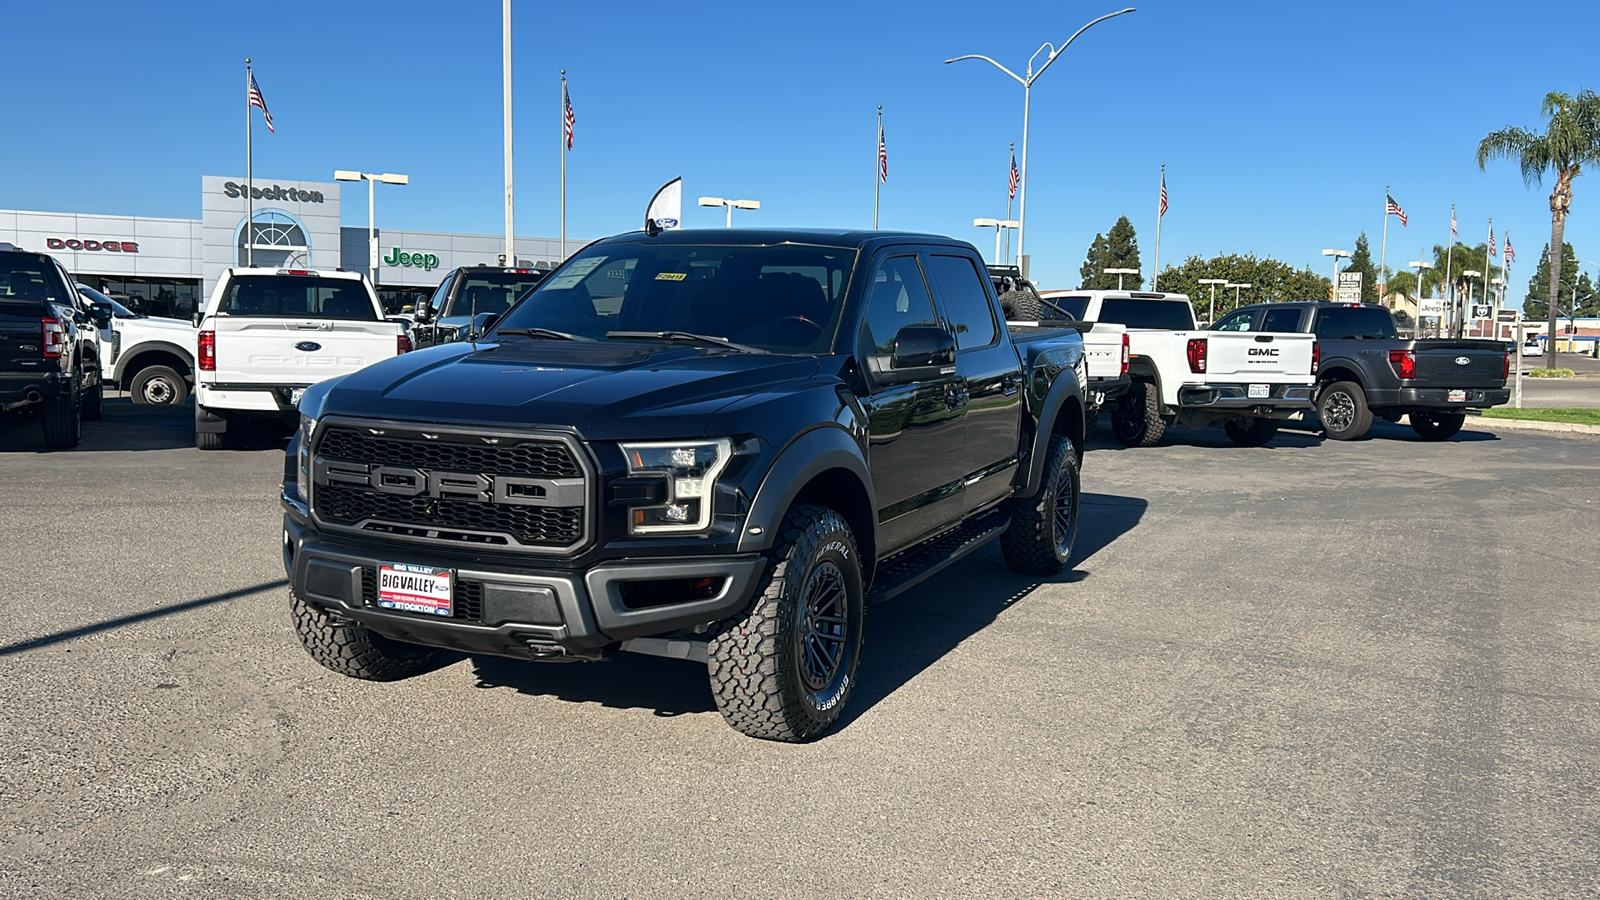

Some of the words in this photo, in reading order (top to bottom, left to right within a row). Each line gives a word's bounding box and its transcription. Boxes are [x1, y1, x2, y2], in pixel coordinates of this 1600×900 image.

[224, 181, 324, 203] Stockton
[47, 238, 139, 253] DODGE
[384, 247, 440, 271] Jeep
[1340, 273, 1360, 281] OEM
[1421, 305, 1441, 313] Jeep
[1248, 348, 1279, 356] GMC
[249, 355, 366, 366] F-150
[314, 456, 585, 508] FORD
[815, 541, 849, 562] GENERAL
[408, 565, 435, 574] VALLEY
[815, 674, 849, 710] GRABBER
